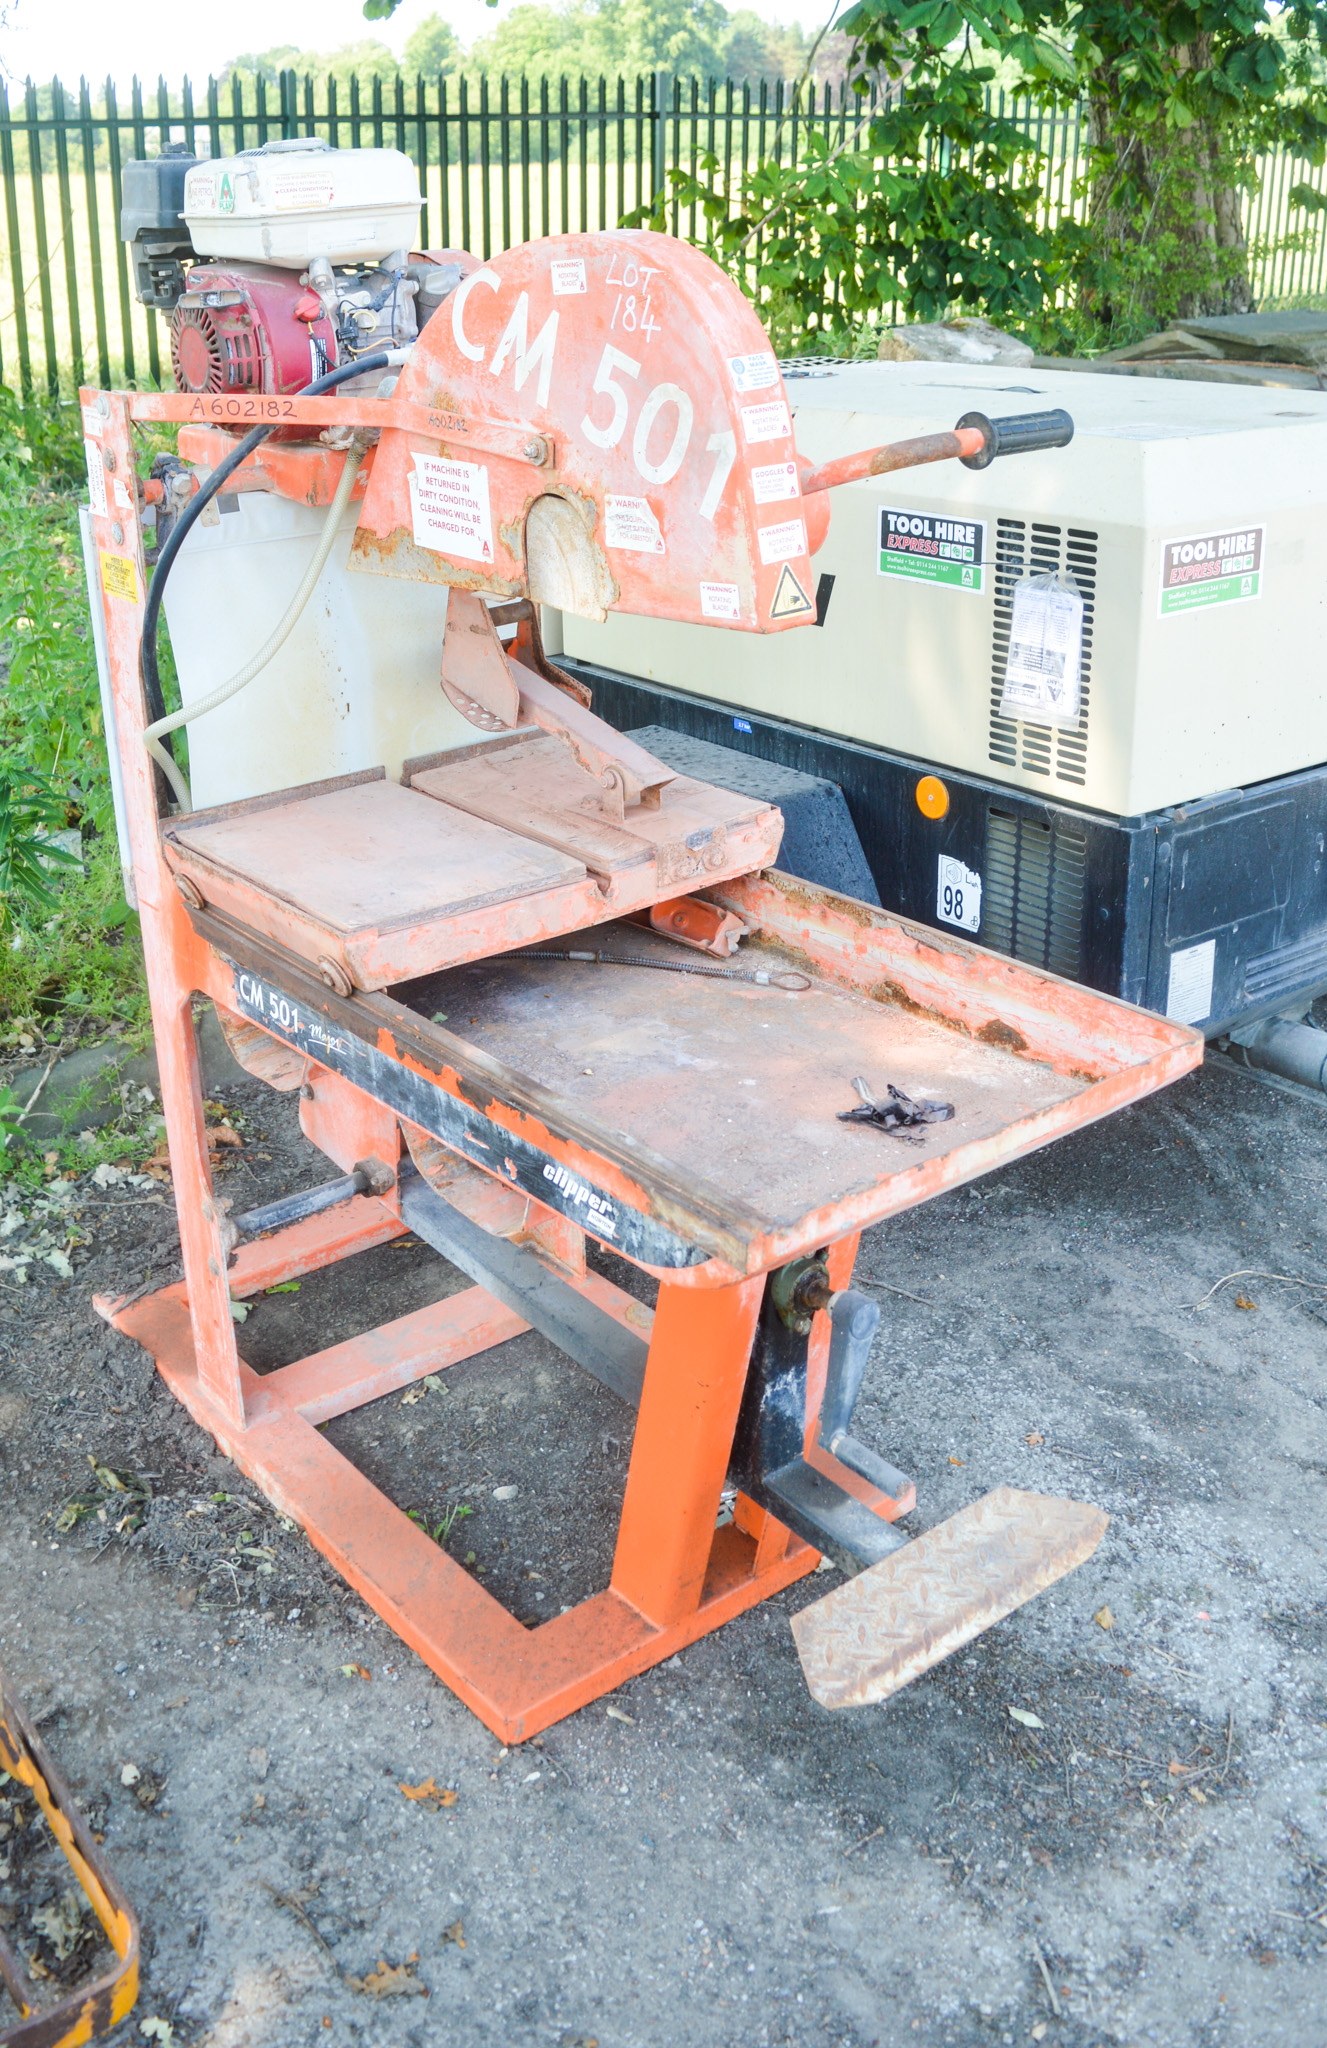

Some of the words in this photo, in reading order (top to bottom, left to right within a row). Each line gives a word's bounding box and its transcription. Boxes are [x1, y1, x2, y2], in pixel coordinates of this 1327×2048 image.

[605, 253, 663, 296] LOT
[610, 293, 662, 344] 184
[452, 268, 560, 409] CM
[189, 397, 298, 418] A602182
[748, 404, 779, 415] WARNING
[752, 415, 780, 425] ROTATING
[580, 343, 737, 522] 501
[757, 424, 777, 434] BLADES
[424, 462, 430, 471] IF
[431, 463, 462, 478] MACHINE
[463, 470, 470, 479] IS
[755, 468, 784, 478] GOGGLES
[425, 476, 461, 491] RETURNED
[462, 484, 470, 493] IN
[418, 489, 437, 500] DIRTY
[615, 499, 641, 509] WARNI
[420, 503, 454, 518] CLEANING
[454, 511, 471, 522] WILL
[472, 514, 481, 524] BE
[428, 518, 460, 533] CHARGED
[765, 524, 796, 536] WARNING
[888, 514, 932, 538] TOOL
[935, 521, 976, 544] HIRE
[768, 535, 796, 547] ROTATING
[887, 534, 938, 555] EXPRESS
[1171, 540, 1216, 565] TOOL
[1218, 532, 1256, 557] HIRE
[773, 545, 793, 555] BLADES
[886, 556, 904, 564] Sheffield
[1169, 560, 1221, 584] EXPRESS
[706, 586, 733, 594] WARNING
[1168, 591, 1187, 600] Sheffield
[1209, 584, 1218, 592] 244
[1219, 582, 1230, 590] 1167
[944, 885, 963, 920] 98
[239, 974, 264, 1014] CM
[269, 991, 298, 1033] 501
[542, 1163, 613, 1214] clipper
[591, 1214, 612, 1230] NORTON
